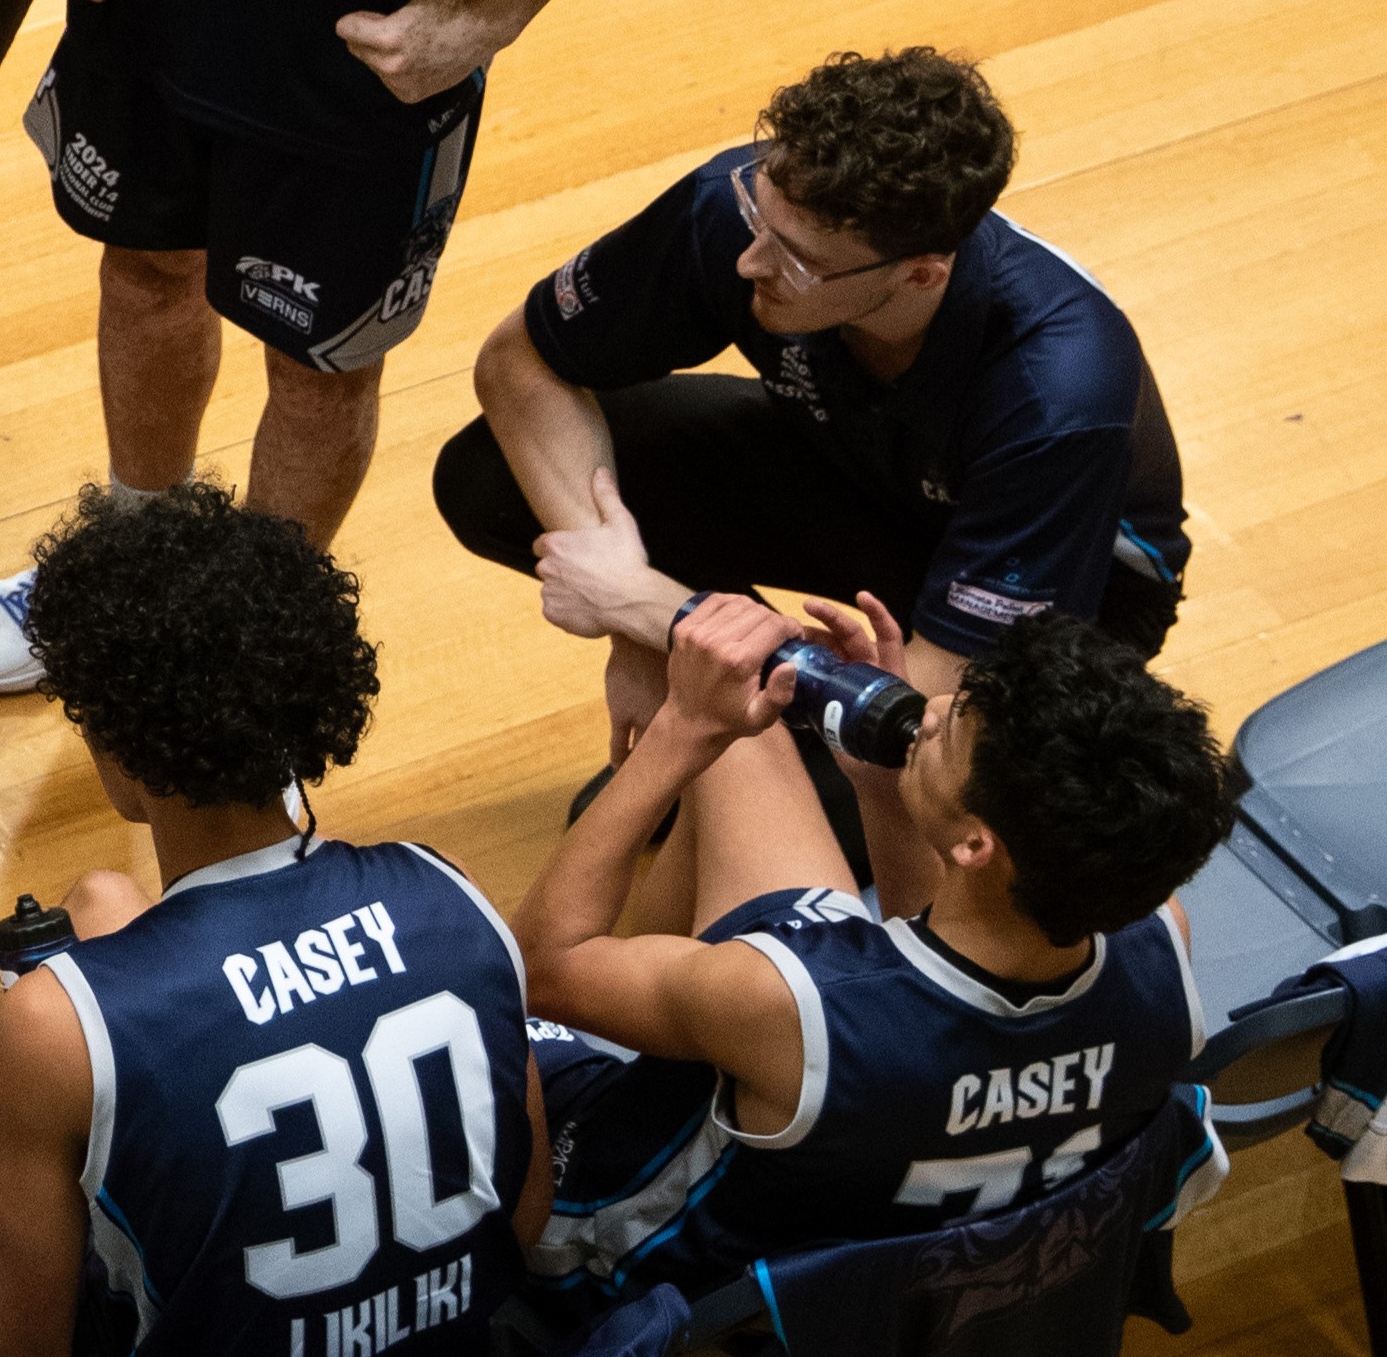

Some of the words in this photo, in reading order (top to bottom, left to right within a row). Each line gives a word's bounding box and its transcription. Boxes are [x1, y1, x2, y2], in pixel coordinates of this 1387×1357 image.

[71, 131, 120, 188] 2024
[243, 283, 310, 329] VERNS
[222, 901, 407, 1025] CASEY
[945, 1042, 1115, 1136] CASEY
[215, 989, 500, 1299] 30
